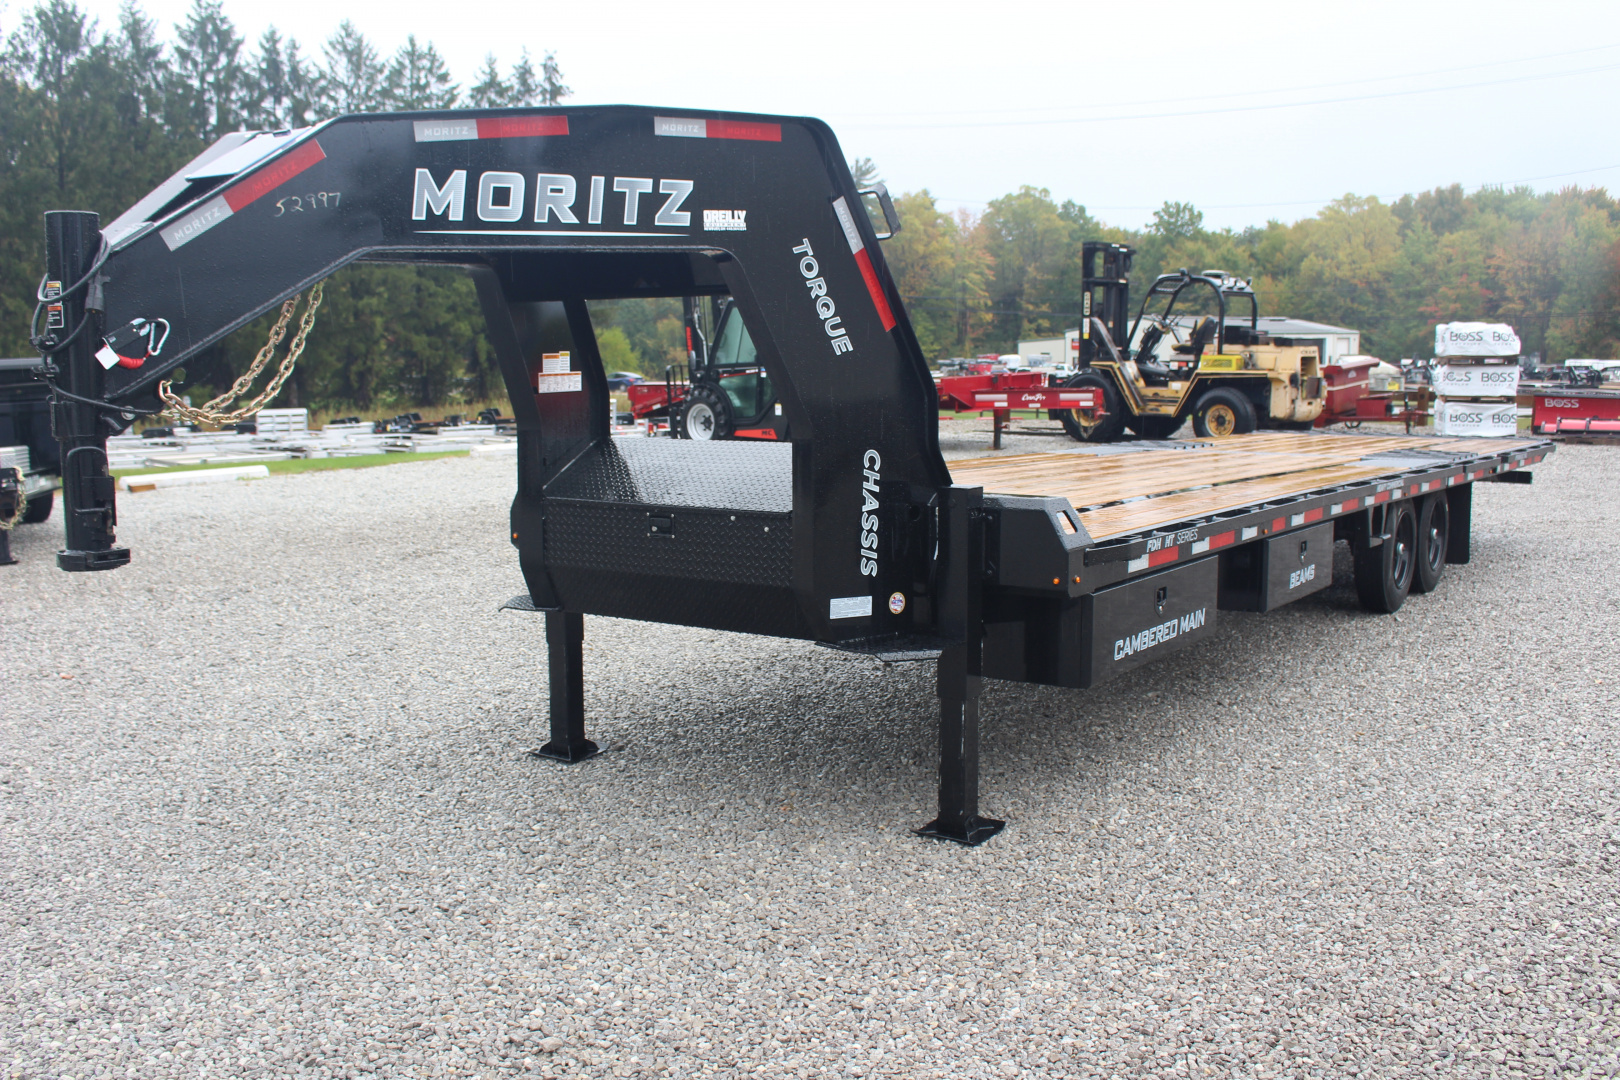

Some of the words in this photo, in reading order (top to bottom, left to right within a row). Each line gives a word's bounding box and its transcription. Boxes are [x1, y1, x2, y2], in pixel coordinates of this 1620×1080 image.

[424, 126, 469, 137] MORITZ
[662, 123, 699, 133] MORITZ
[274, 192, 341, 217] 52997
[411, 167, 694, 227] MORITZ
[173, 206, 222, 241] MORITZ
[838, 206, 857, 244] MORITZ
[792, 237, 854, 356] TORQUE
[1449, 331, 1483, 341] BOSS
[1481, 372, 1514, 382] BOSS
[1544, 398, 1579, 408] BOSS
[1449, 412, 1482, 423] BOSS
[860, 449, 881, 577] CHASSIS
[1176, 528, 1198, 545] SERIES
[1289, 564, 1315, 590] BEAMS
[1114, 618, 1178, 661] CAMBERED
[1180, 607, 1206, 635] MAIN
